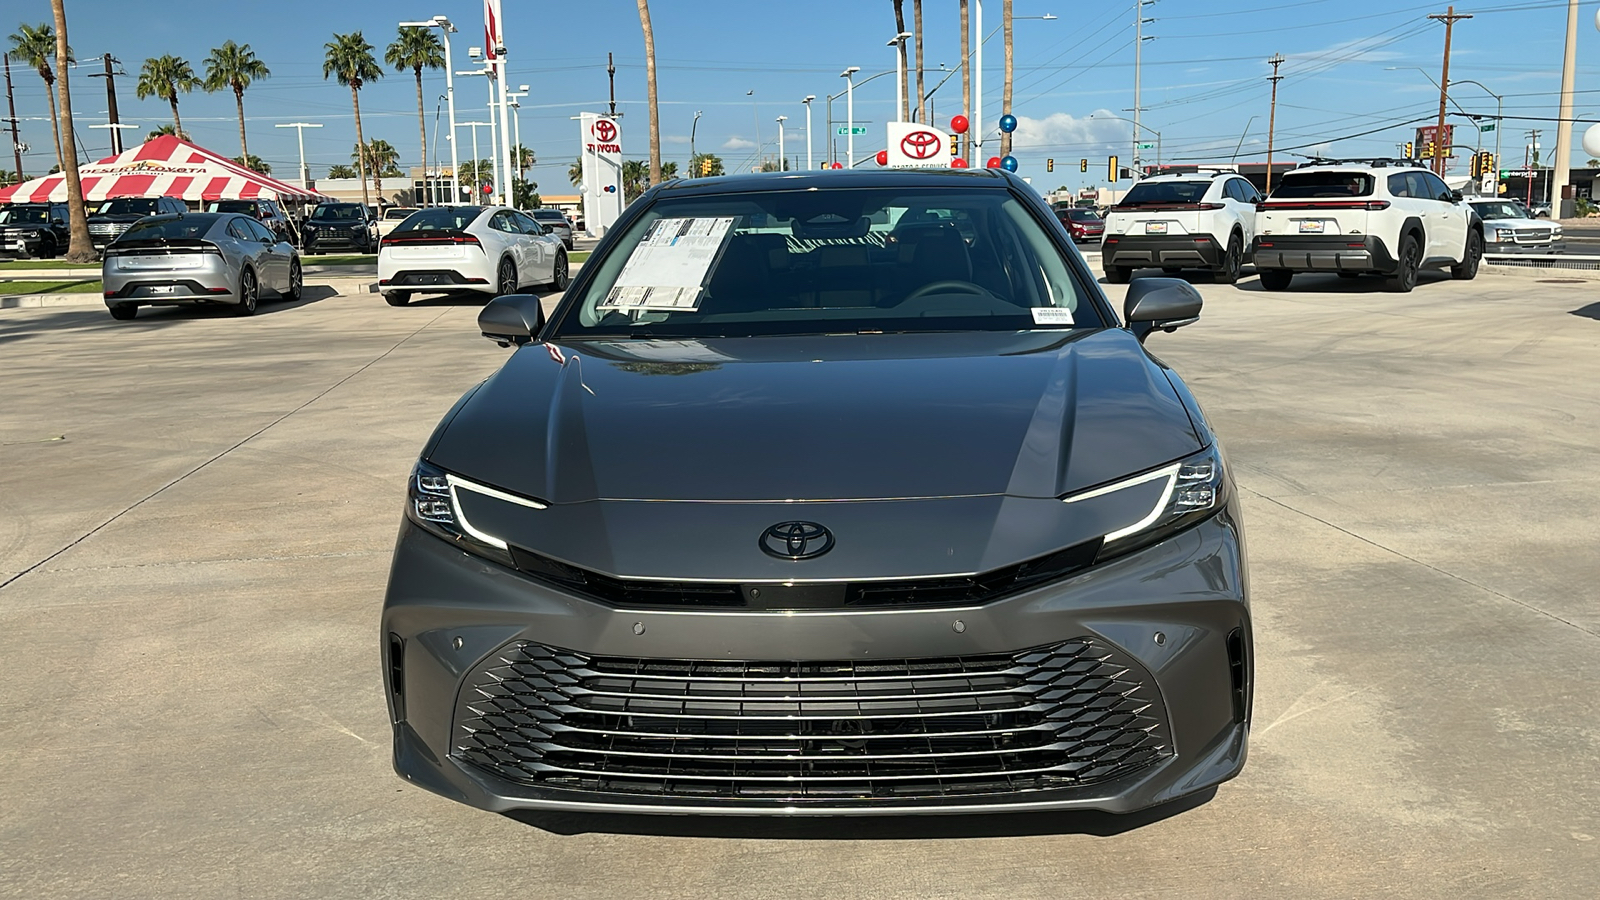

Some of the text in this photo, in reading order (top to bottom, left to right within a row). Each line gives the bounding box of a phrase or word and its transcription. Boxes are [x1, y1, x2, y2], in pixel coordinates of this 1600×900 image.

[587, 143, 621, 153] TOYOTA
[80, 166, 136, 174] DESERT
[145, 165, 207, 173] TOYOTA
